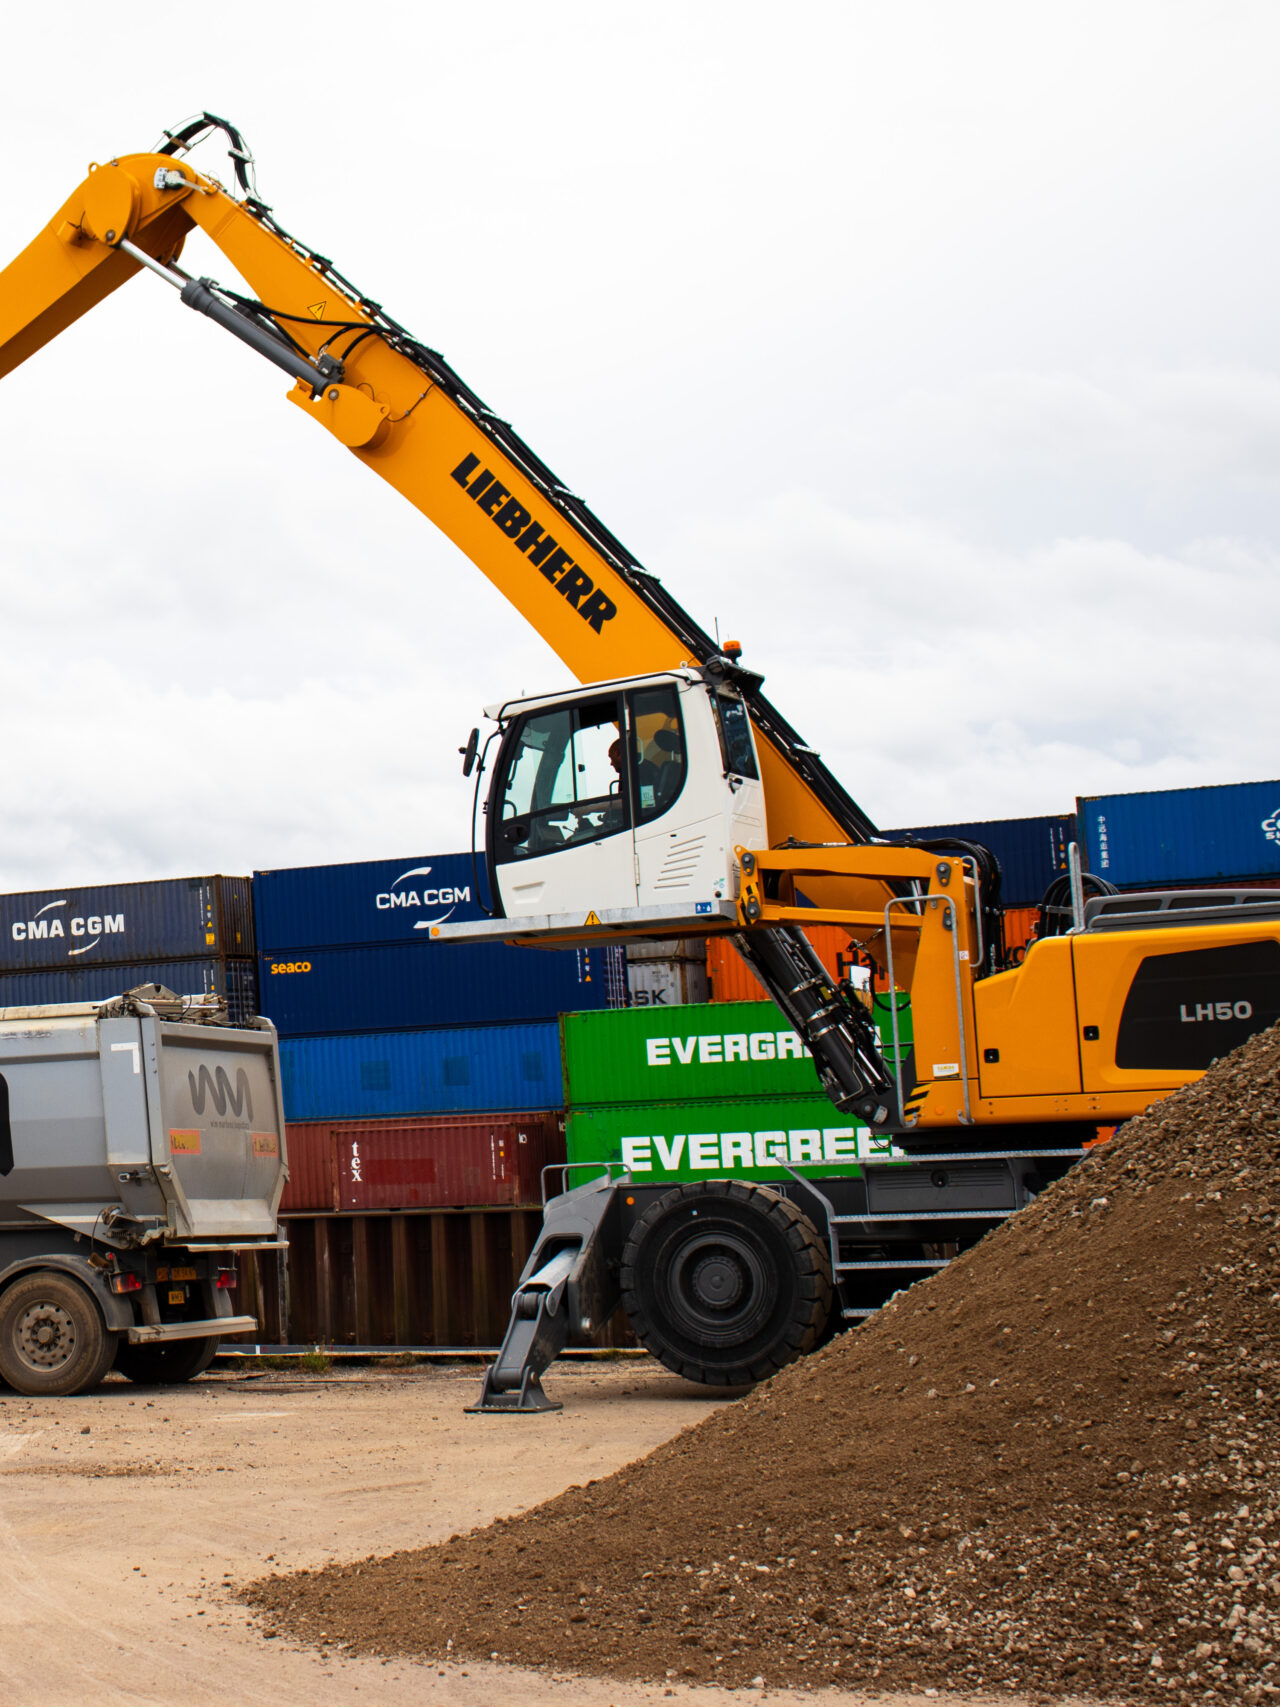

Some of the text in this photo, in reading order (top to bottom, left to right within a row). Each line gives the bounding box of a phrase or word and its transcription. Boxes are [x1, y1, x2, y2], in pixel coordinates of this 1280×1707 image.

[450, 452, 617, 635] LIEBHERR
[376, 886, 470, 910] CMA CGM
[12, 914, 125, 941] CMA CGM
[271, 961, 312, 975] seaco
[1180, 1000, 1253, 1022] LH50
[351, 1141, 363, 1182] tex
